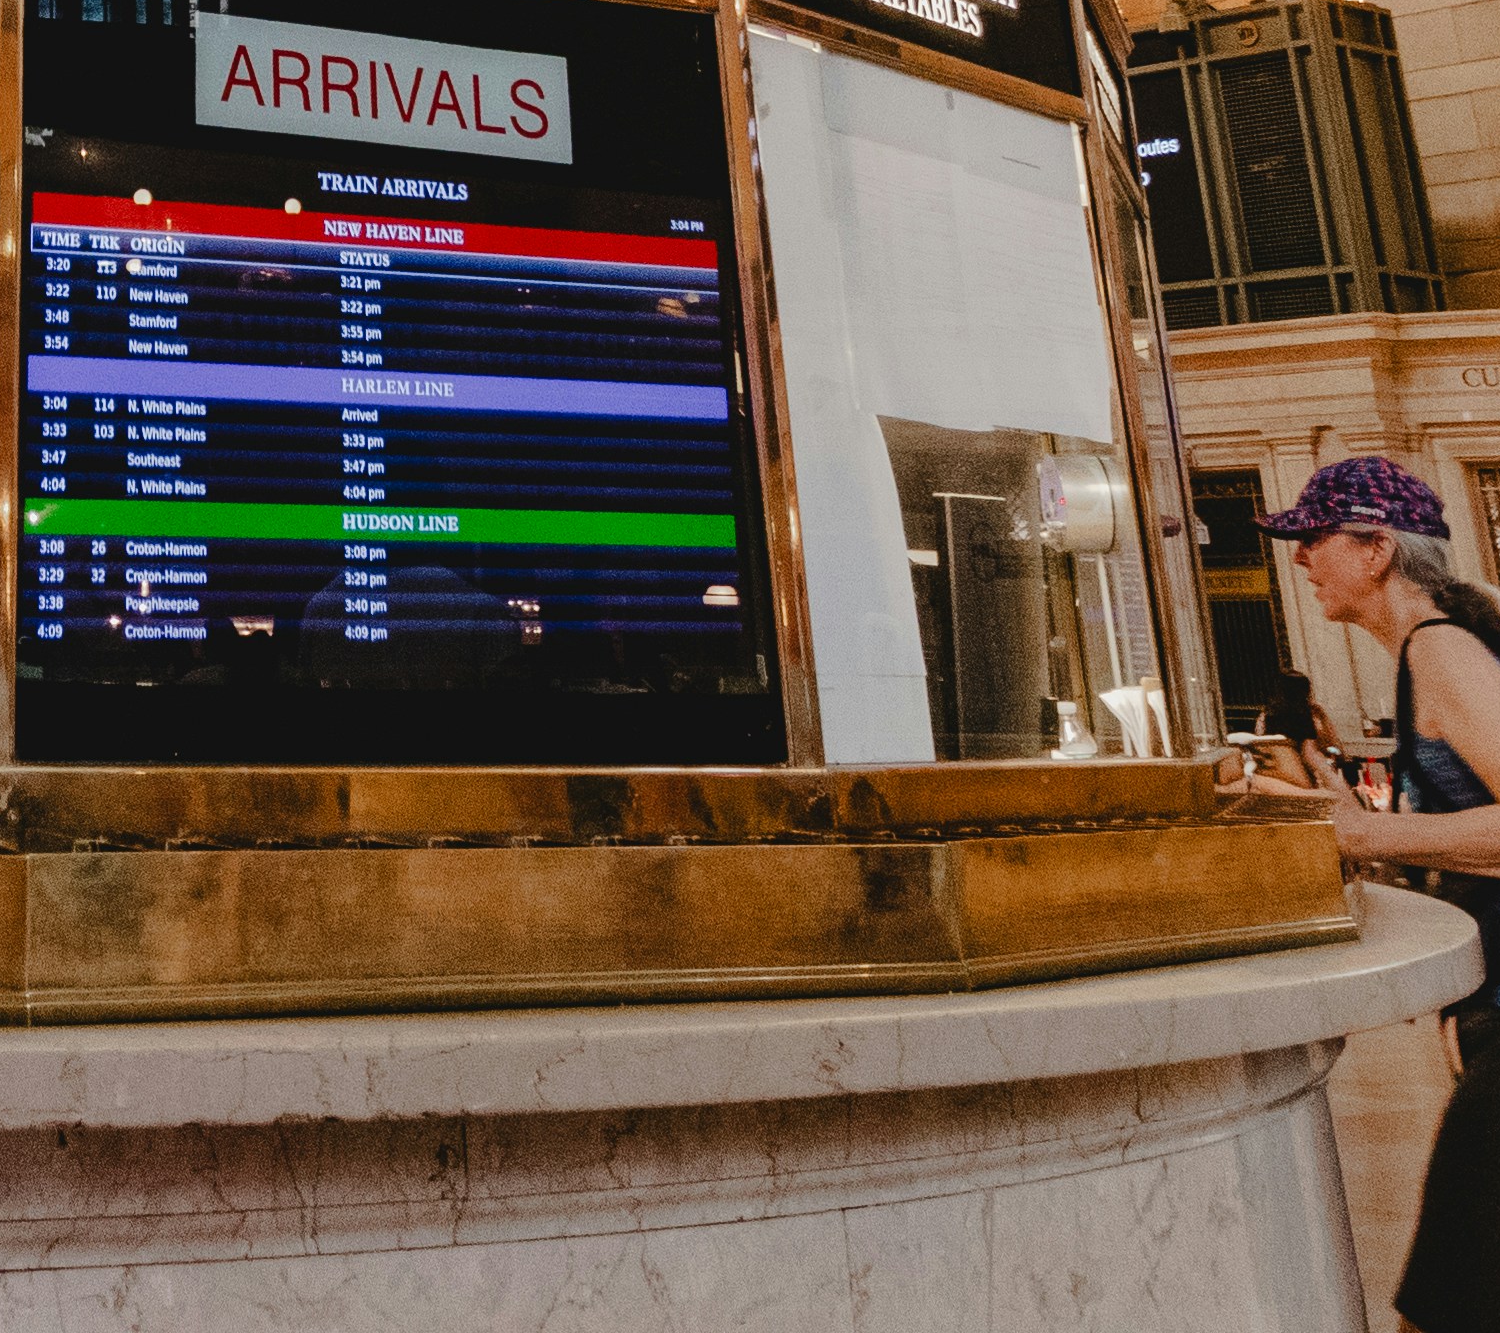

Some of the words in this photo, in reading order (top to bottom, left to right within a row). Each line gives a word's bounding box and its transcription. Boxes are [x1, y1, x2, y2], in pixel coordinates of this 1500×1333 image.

[221, 44, 550, 140] ARRIVALS
[318, 172, 378, 195] TRAIN
[381, 177, 468, 201] ARRIVALS
[324, 220, 362, 237] NEW
[365, 222, 421, 242] HAVEN
[425, 226, 465, 245] LINE
[40, 231, 80, 249] TIME
[89, 233, 120, 250] TRK
[130, 237, 185, 255] ORIGIN
[340, 251, 390, 267] STATUS
[46, 257, 70, 272] 3:20
[340, 275, 362, 290] 3:21
[46, 283, 70, 299] 3:22
[96, 286, 117, 301] 110
[129, 287, 152, 303] New
[155, 289, 188, 306] Haven
[340, 300, 363, 314] 3:22
[45, 309, 70, 324] 3:48
[128, 313, 178, 330] Stamford
[341, 325, 363, 339] 3:55
[44, 335, 69, 351] 3:54
[128, 339, 152, 355] New
[154, 341, 188, 356] Haven
[341, 350, 364, 364] 3:54
[341, 377, 410, 396] HARLEM
[415, 381, 455, 398] LINE
[43, 396, 67, 411] 3:04
[94, 397, 115, 412] 114
[127, 399, 139, 414] N.
[142, 400, 173, 415] White
[175, 400, 206, 416] Plains
[341, 408, 379, 422] Arrived
[42, 423, 67, 438] 3:33
[94, 424, 114, 439] 103
[127, 425, 139, 440] N.
[141, 426, 173, 441] White
[175, 427, 206, 442] Plains
[342, 433, 366, 448] 3:33
[41, 450, 67, 465] 3:47
[127, 452, 182, 468] Southeast
[343, 459, 366, 474] 3:47
[40, 477, 66, 492] 4:04
[126, 479, 139, 494] N.
[141, 479, 173, 495] White
[175, 480, 206, 496] Plains
[343, 484, 366, 500] 4:04
[342, 513, 414, 531] HUDSON
[418, 515, 460, 533] LINE
[39, 540, 64, 555] 3:08
[91, 540, 106, 555] 26
[125, 541, 207, 557] Croton-Harmon
[344, 545, 367, 559] 3:08
[38, 567, 64, 583] 3:29
[91, 568, 106, 583] 32
[125, 569, 207, 584] Croton-Harmon
[344, 571, 367, 586] 3:29
[38, 595, 64, 610] 3:38
[125, 597, 199, 614] Poughkeepsie
[345, 598, 368, 612] 3:40
[37, 623, 63, 639] 4:09
[125, 624, 207, 640] Croton-Harmon
[344, 626, 369, 640] 4:09
